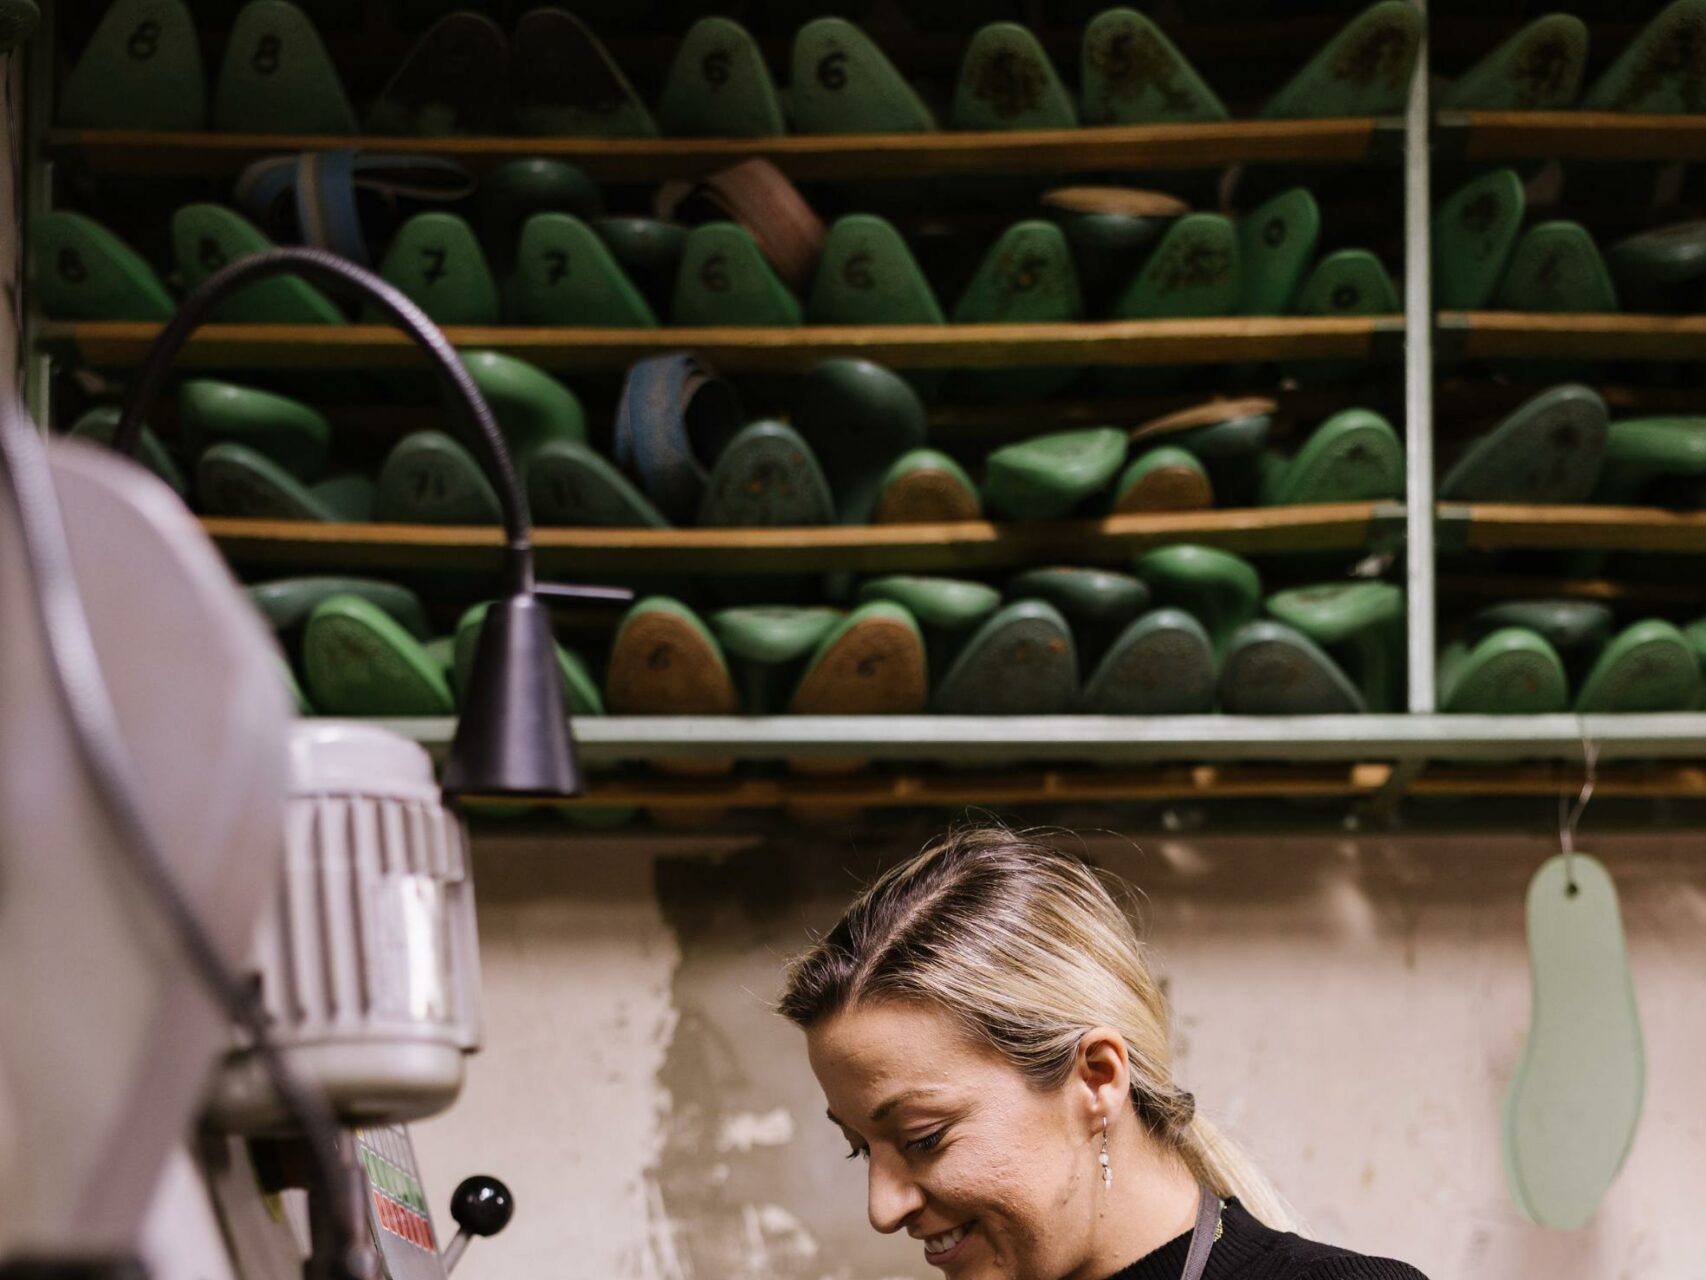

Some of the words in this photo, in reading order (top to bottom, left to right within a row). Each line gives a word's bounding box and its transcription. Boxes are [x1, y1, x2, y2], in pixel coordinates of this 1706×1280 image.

[127, 19, 161, 61] 8
[252, 33, 282, 75] 8
[817, 51, 849, 90] 6
[421, 247, 448, 286] 7
[543, 247, 571, 286] 7
[701, 255, 732, 293] 6
[843, 253, 875, 290] 6
